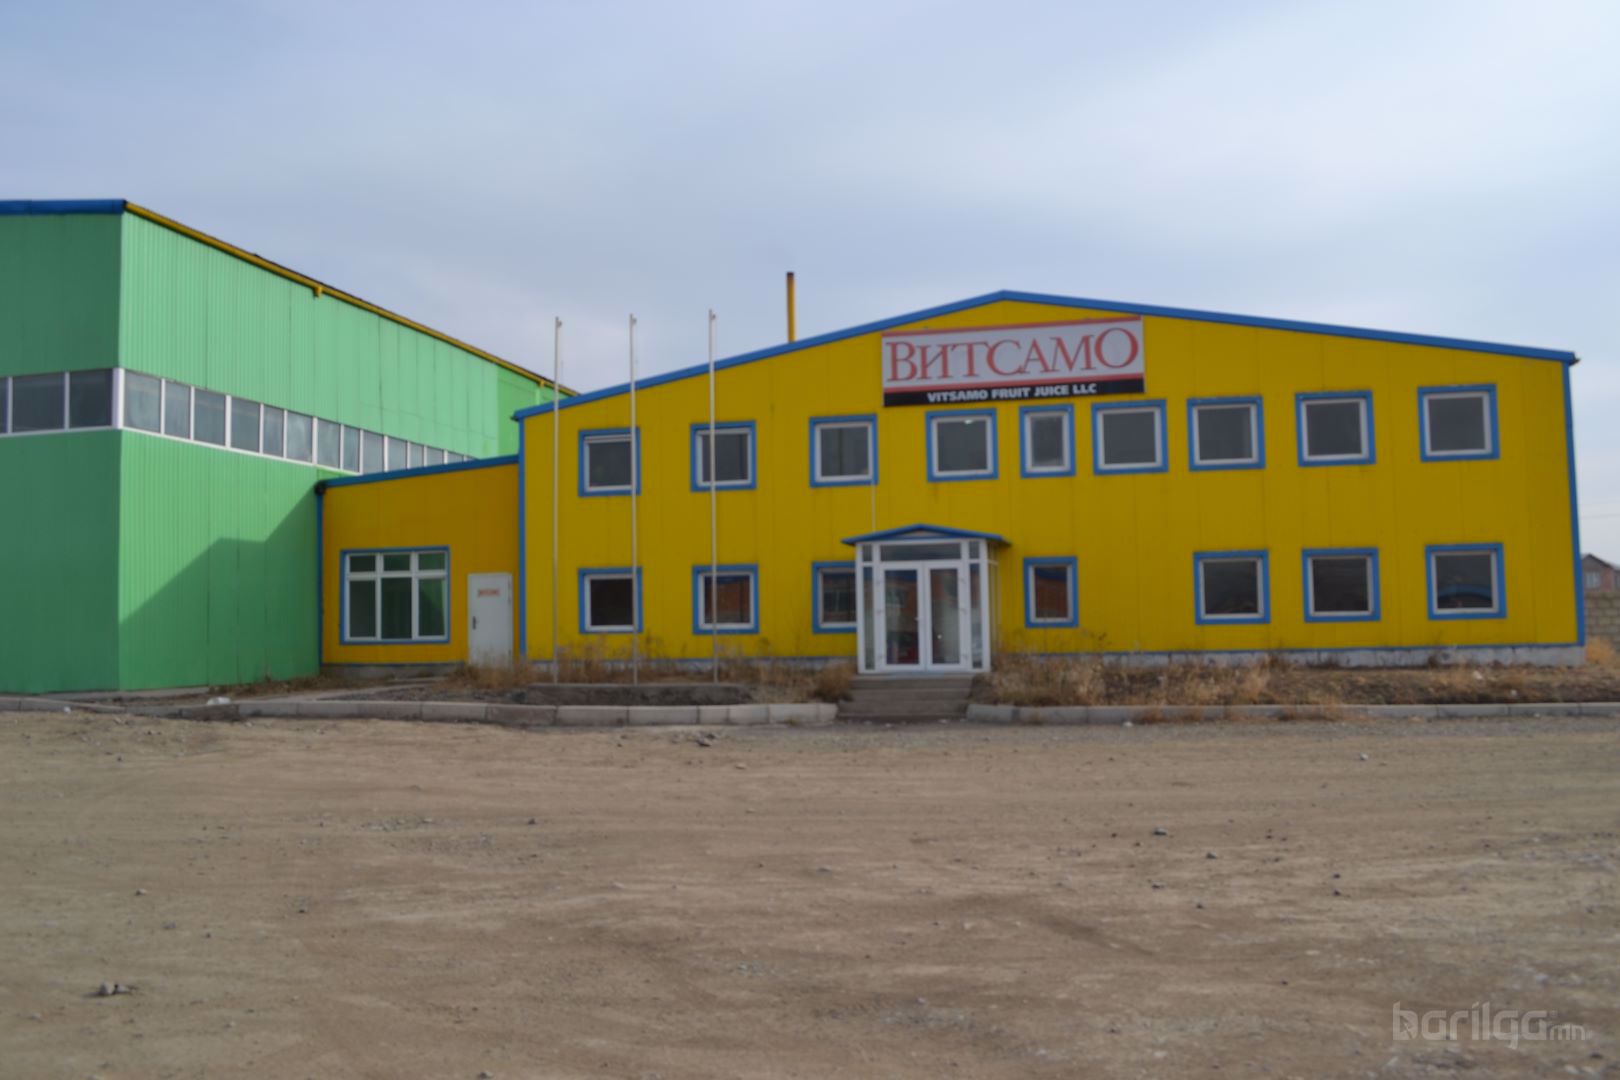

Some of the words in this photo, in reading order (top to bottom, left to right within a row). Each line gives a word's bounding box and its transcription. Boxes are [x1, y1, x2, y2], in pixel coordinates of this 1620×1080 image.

[886, 327, 1139, 382] ВИТСАМО
[927, 389, 989, 403] VITSAMO
[991, 387, 1031, 399] FRUIT
[1034, 385, 1070, 398] JUICE
[1073, 383, 1097, 395] LLC
